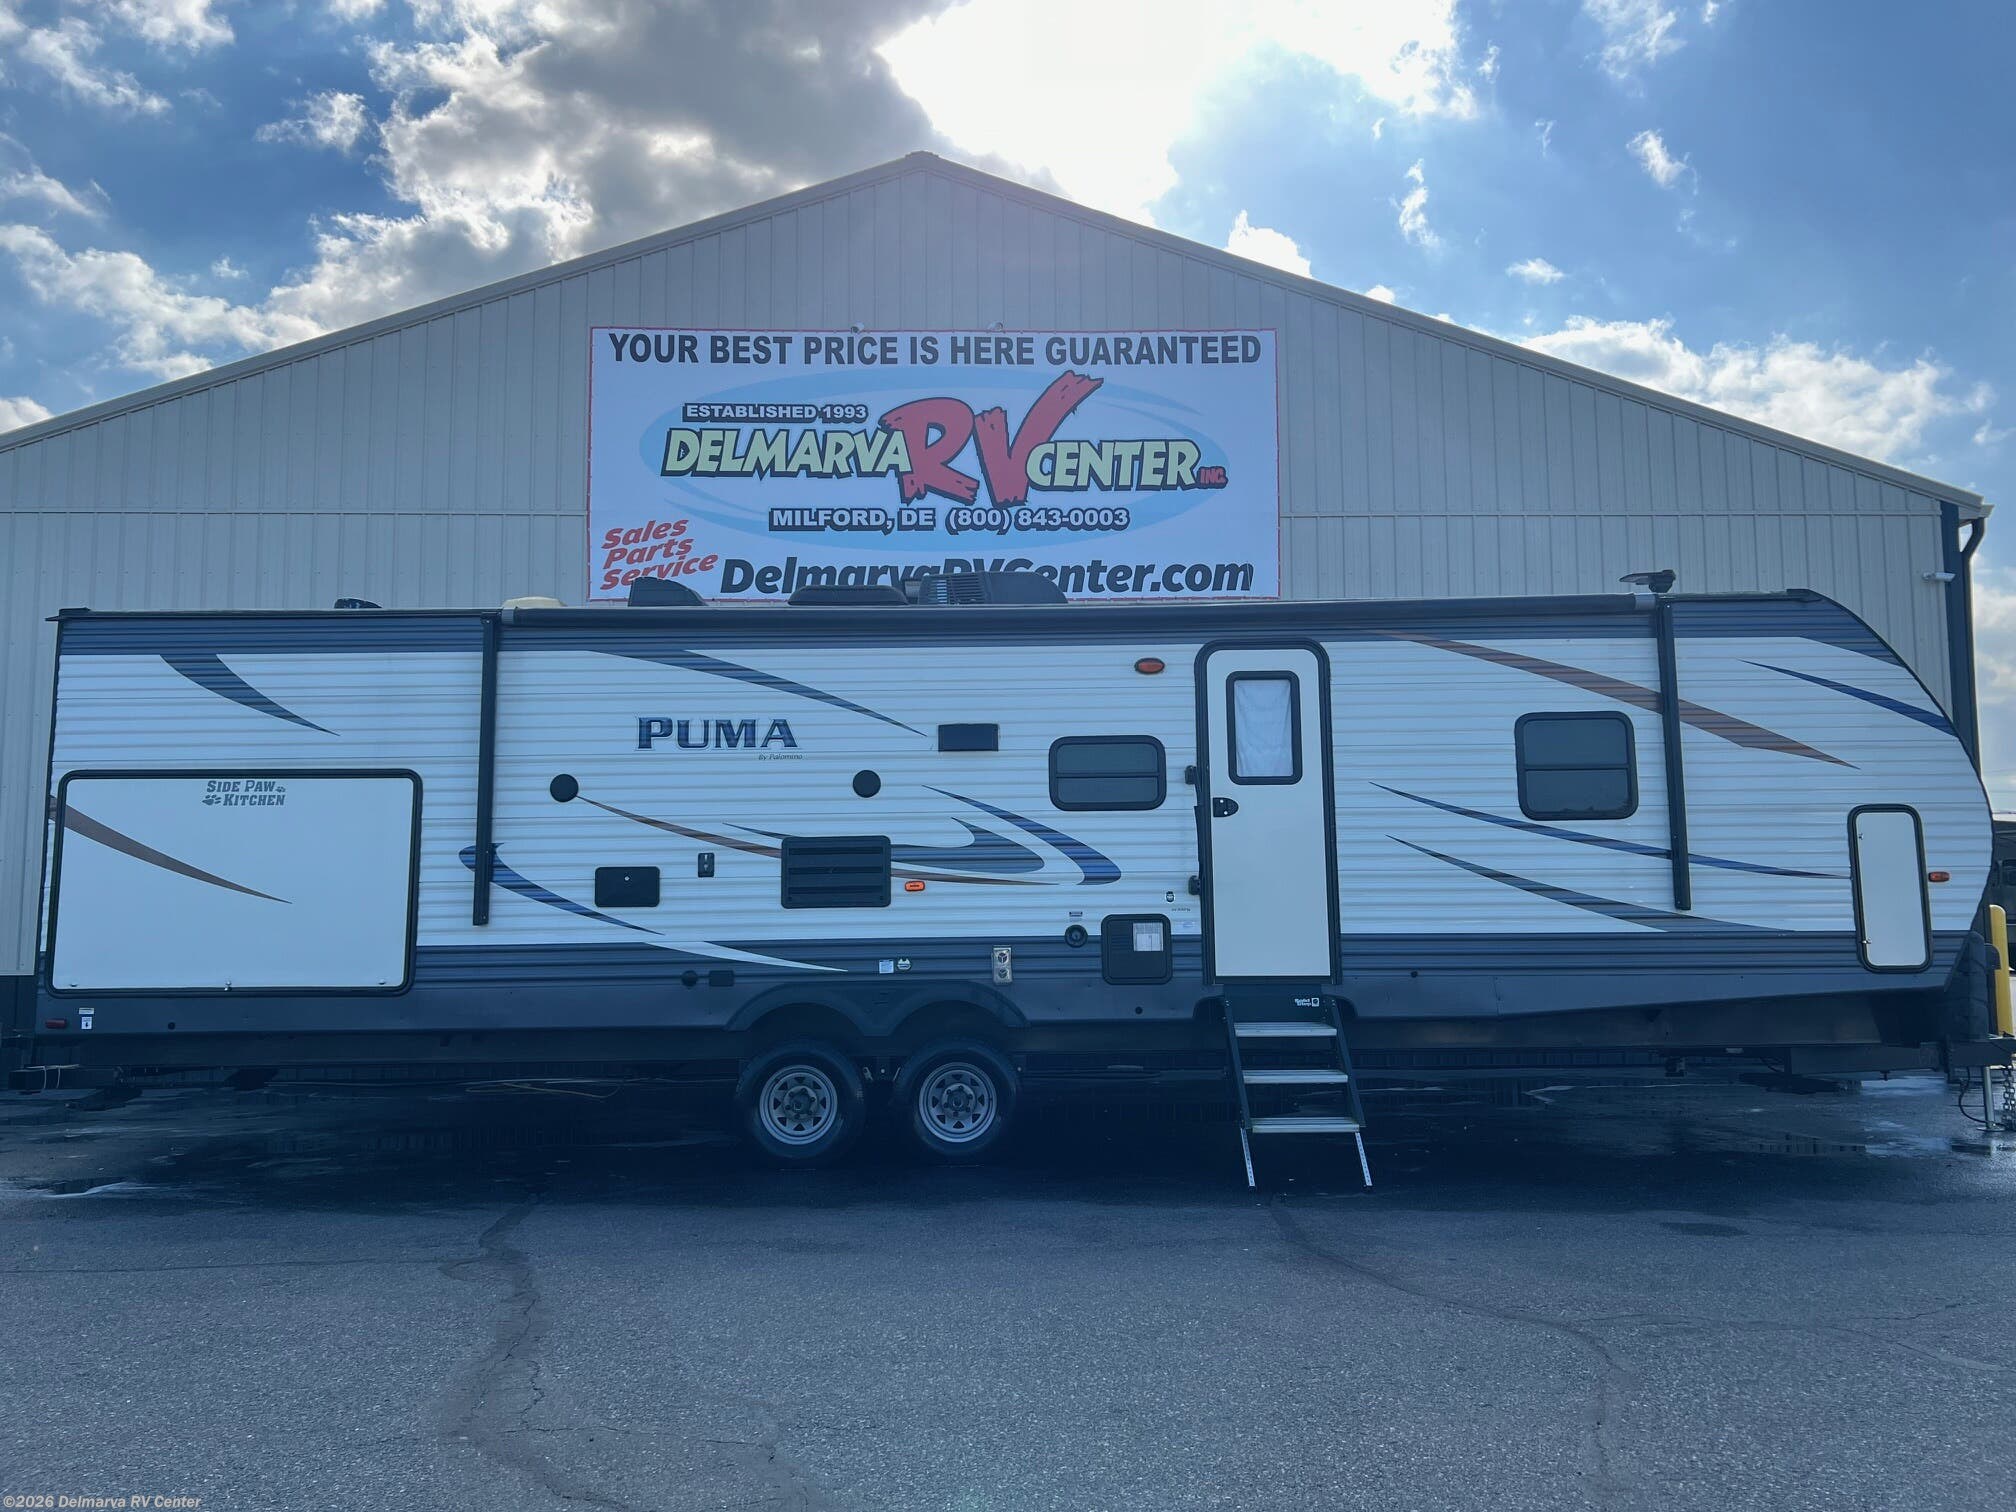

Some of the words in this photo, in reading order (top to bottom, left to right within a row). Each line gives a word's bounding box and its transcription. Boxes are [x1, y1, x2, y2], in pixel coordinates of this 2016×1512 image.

[609, 333, 698, 363] YOUR
[710, 335, 792, 364] BEST
[804, 336, 898, 365] PRICE
[910, 336, 939, 365] IS
[950, 336, 1034, 365] HERE
[1046, 335, 1261, 366] GUARANTEED
[685, 404, 817, 421] ESTABLISHED
[822, 405, 867, 421] 1993
[662, 428, 913, 478] DELMARVA
[878, 370, 1104, 507] RV
[1026, 440, 1201, 488] CENTER
[601, 519, 689, 549] Sales
[770, 508, 894, 533] MILFORD,
[899, 508, 936, 531] DE
[947, 508, 1010, 533] (800)
[1015, 508, 1130, 531] 843-0003
[603, 538, 695, 569] Parts
[599, 554, 719, 590] Service
[637, 716, 798, 749] PUMA
[206, 780, 241, 793] SIDE
[244, 780, 276, 793] PAW
[222, 794, 286, 806] KITCHEN
